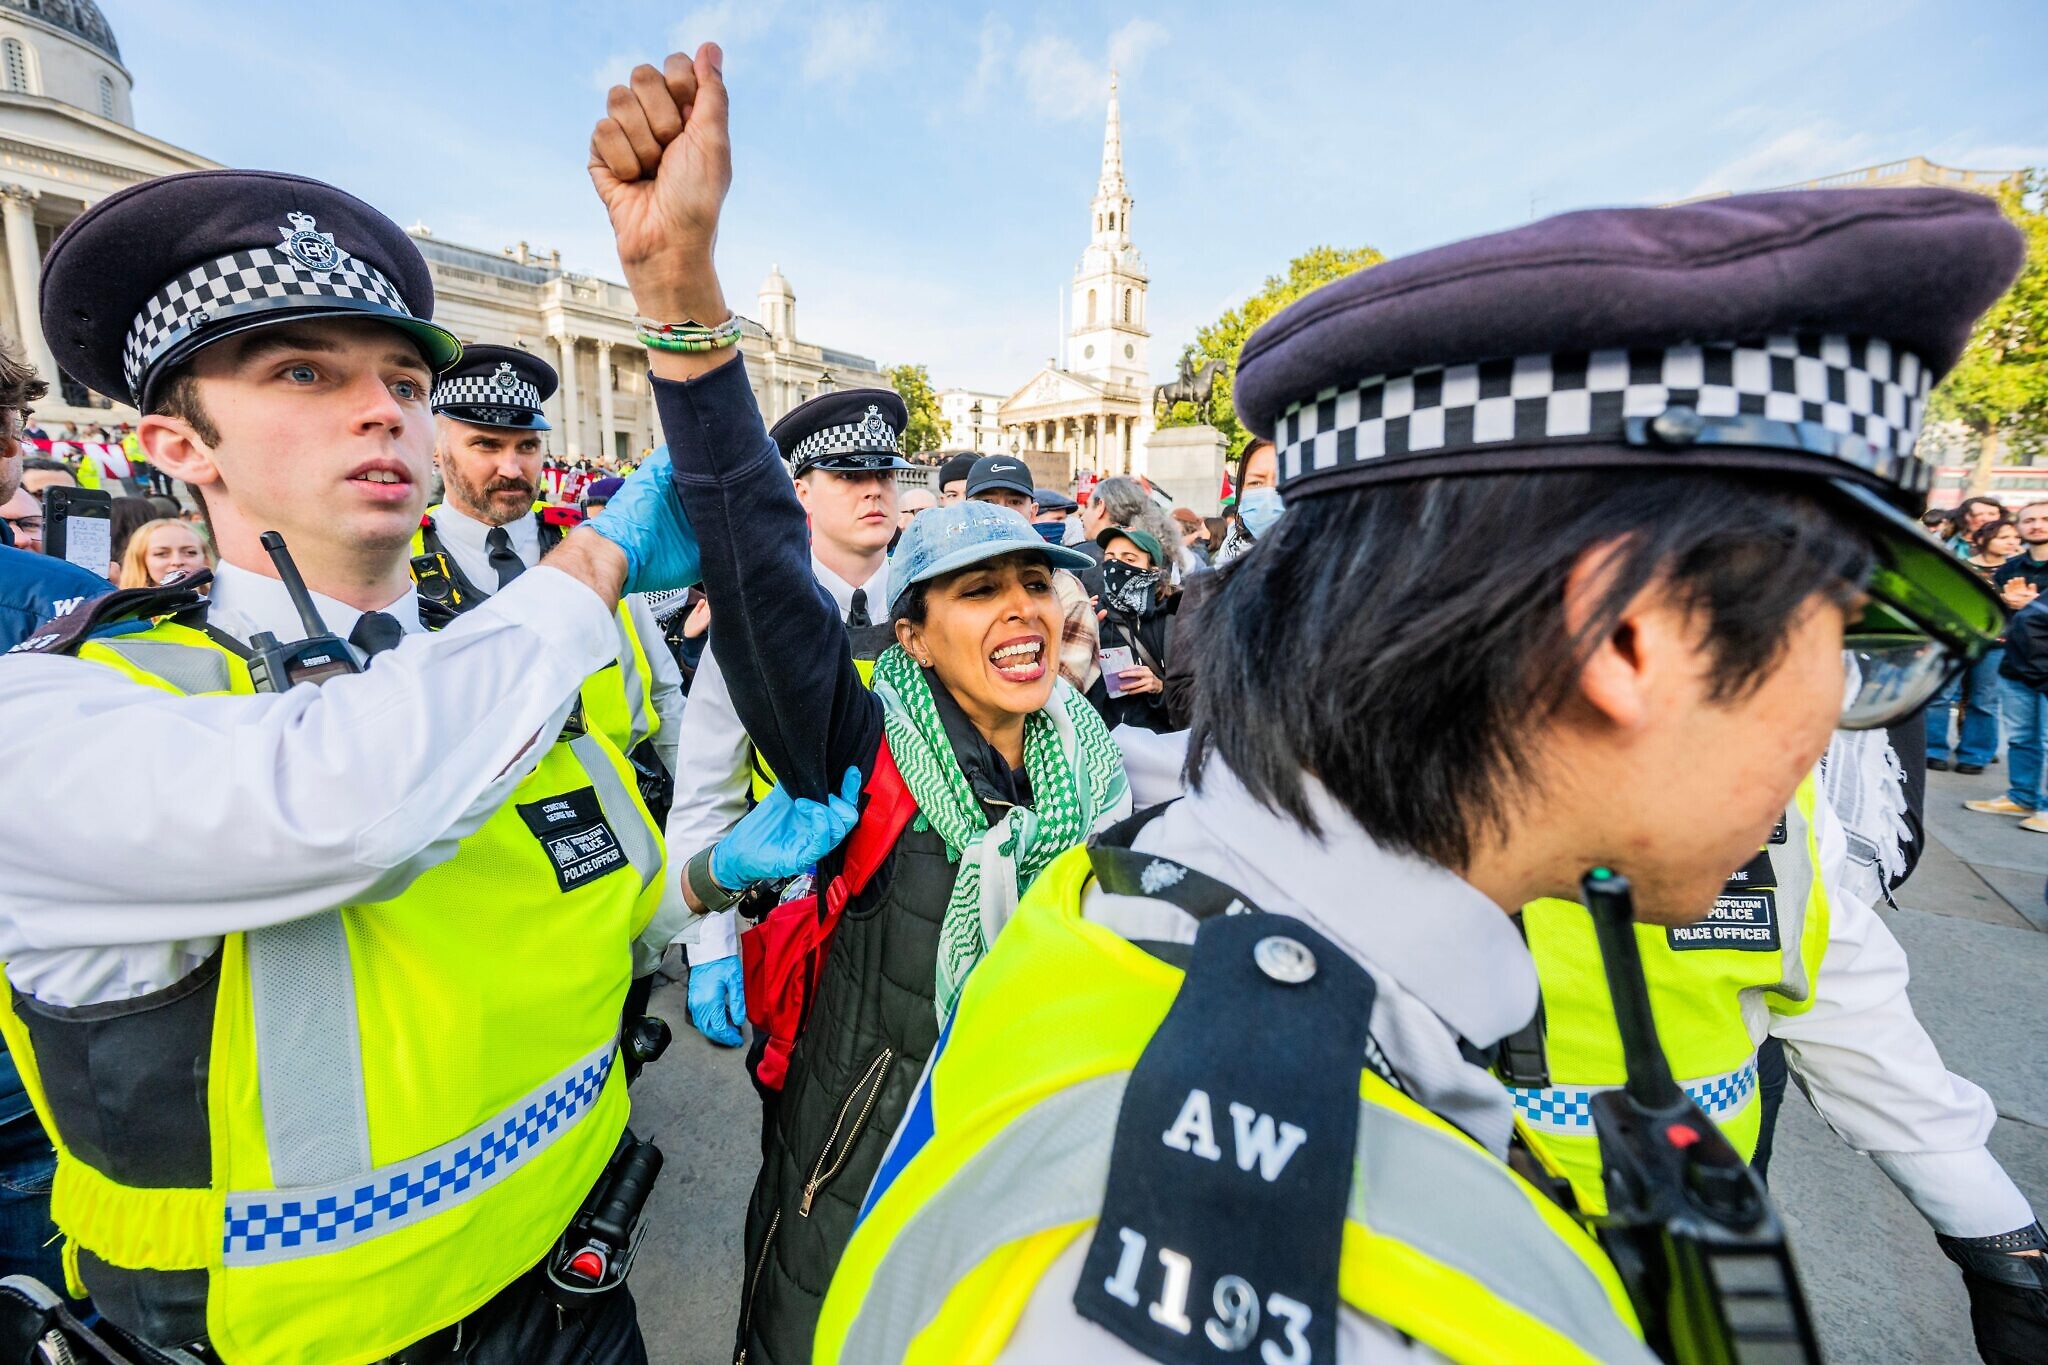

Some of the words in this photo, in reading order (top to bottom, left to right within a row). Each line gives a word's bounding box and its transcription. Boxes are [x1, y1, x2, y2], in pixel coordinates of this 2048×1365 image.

[579, 836, 606, 853] POLICE
[563, 861, 594, 883] POLICE
[591, 848, 620, 869] OFFICER
[1707, 908, 1754, 920] POLICE
[1673, 928, 1712, 941] POLICE
[1713, 926, 1771, 941] OFFICER
[1162, 1088, 1308, 1182] AW
[1104, 1226, 1312, 1365] 1193
